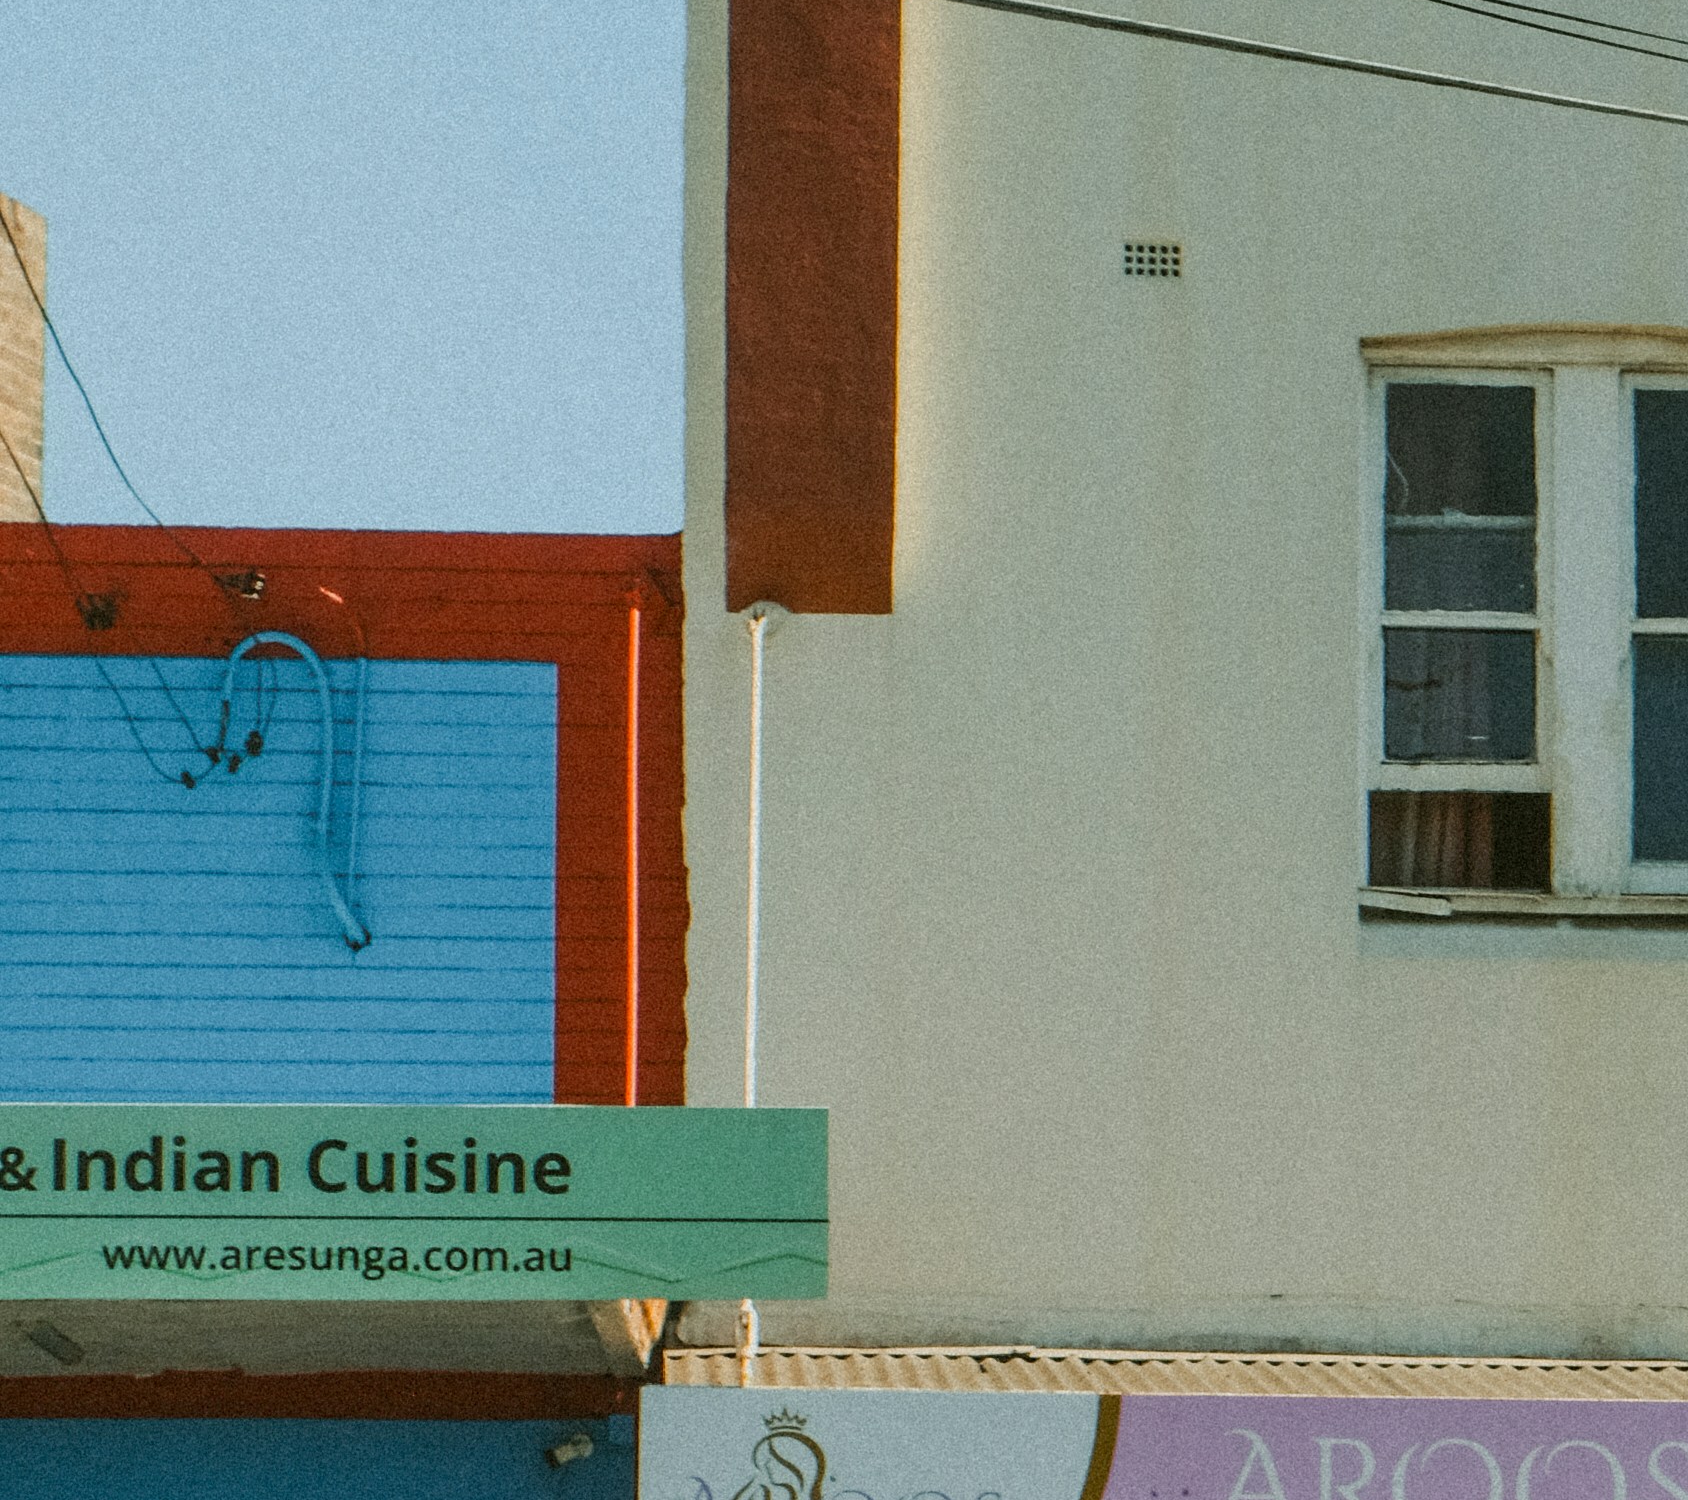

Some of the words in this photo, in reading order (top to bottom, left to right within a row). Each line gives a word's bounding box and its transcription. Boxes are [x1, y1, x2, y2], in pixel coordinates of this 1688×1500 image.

[0, 1146, 36, 1192] &
[53, 1135, 279, 1193] Indian
[307, 1136, 571, 1195] Cuisine
[102, 1245, 573, 1281] www.aresunga.com.au
